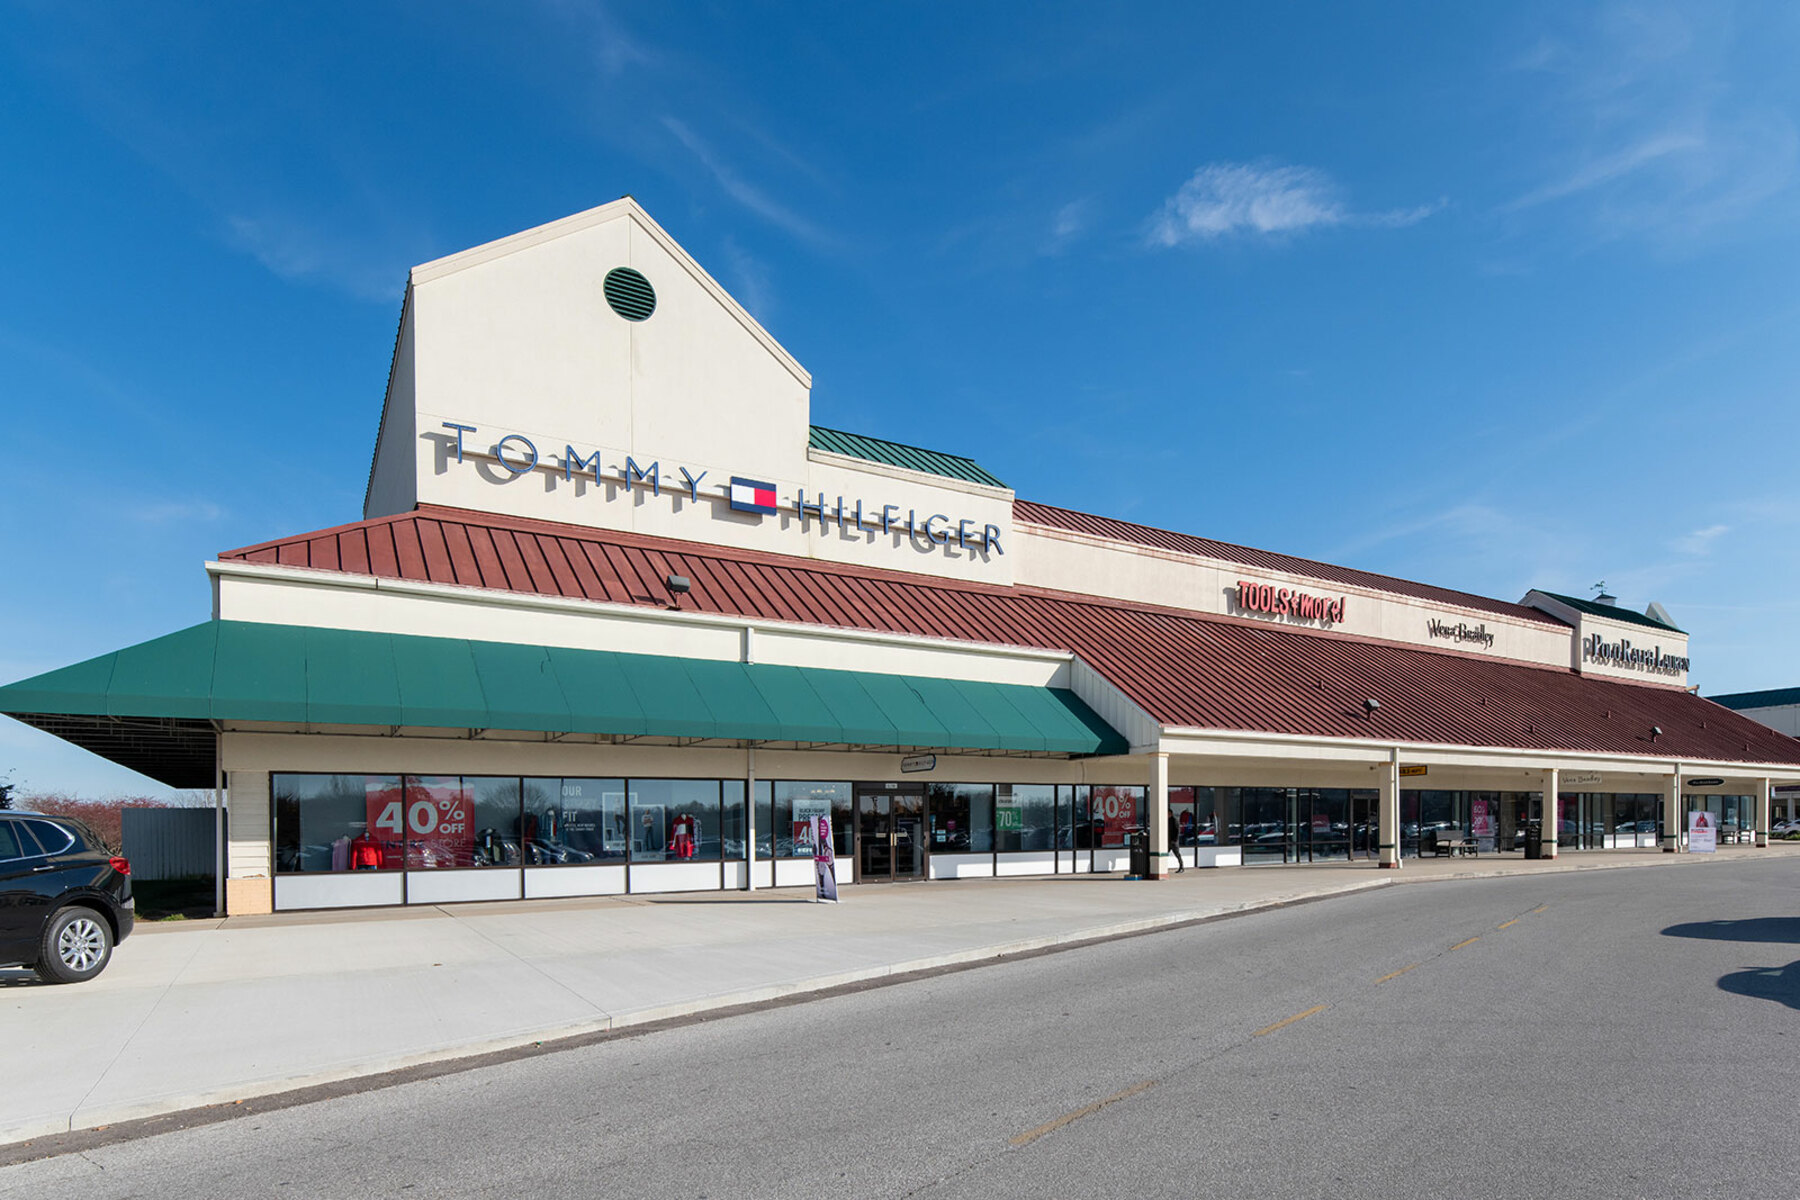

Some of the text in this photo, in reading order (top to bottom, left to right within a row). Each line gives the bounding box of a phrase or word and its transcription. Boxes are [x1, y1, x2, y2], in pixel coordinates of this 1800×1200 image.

[441, 421, 1005, 556] TOMMY HILFIGER
[561, 785, 582, 797] OUR
[376, 800, 465, 835] 40%
[562, 811, 577, 823] FIT
[439, 822, 465, 834] OFF
